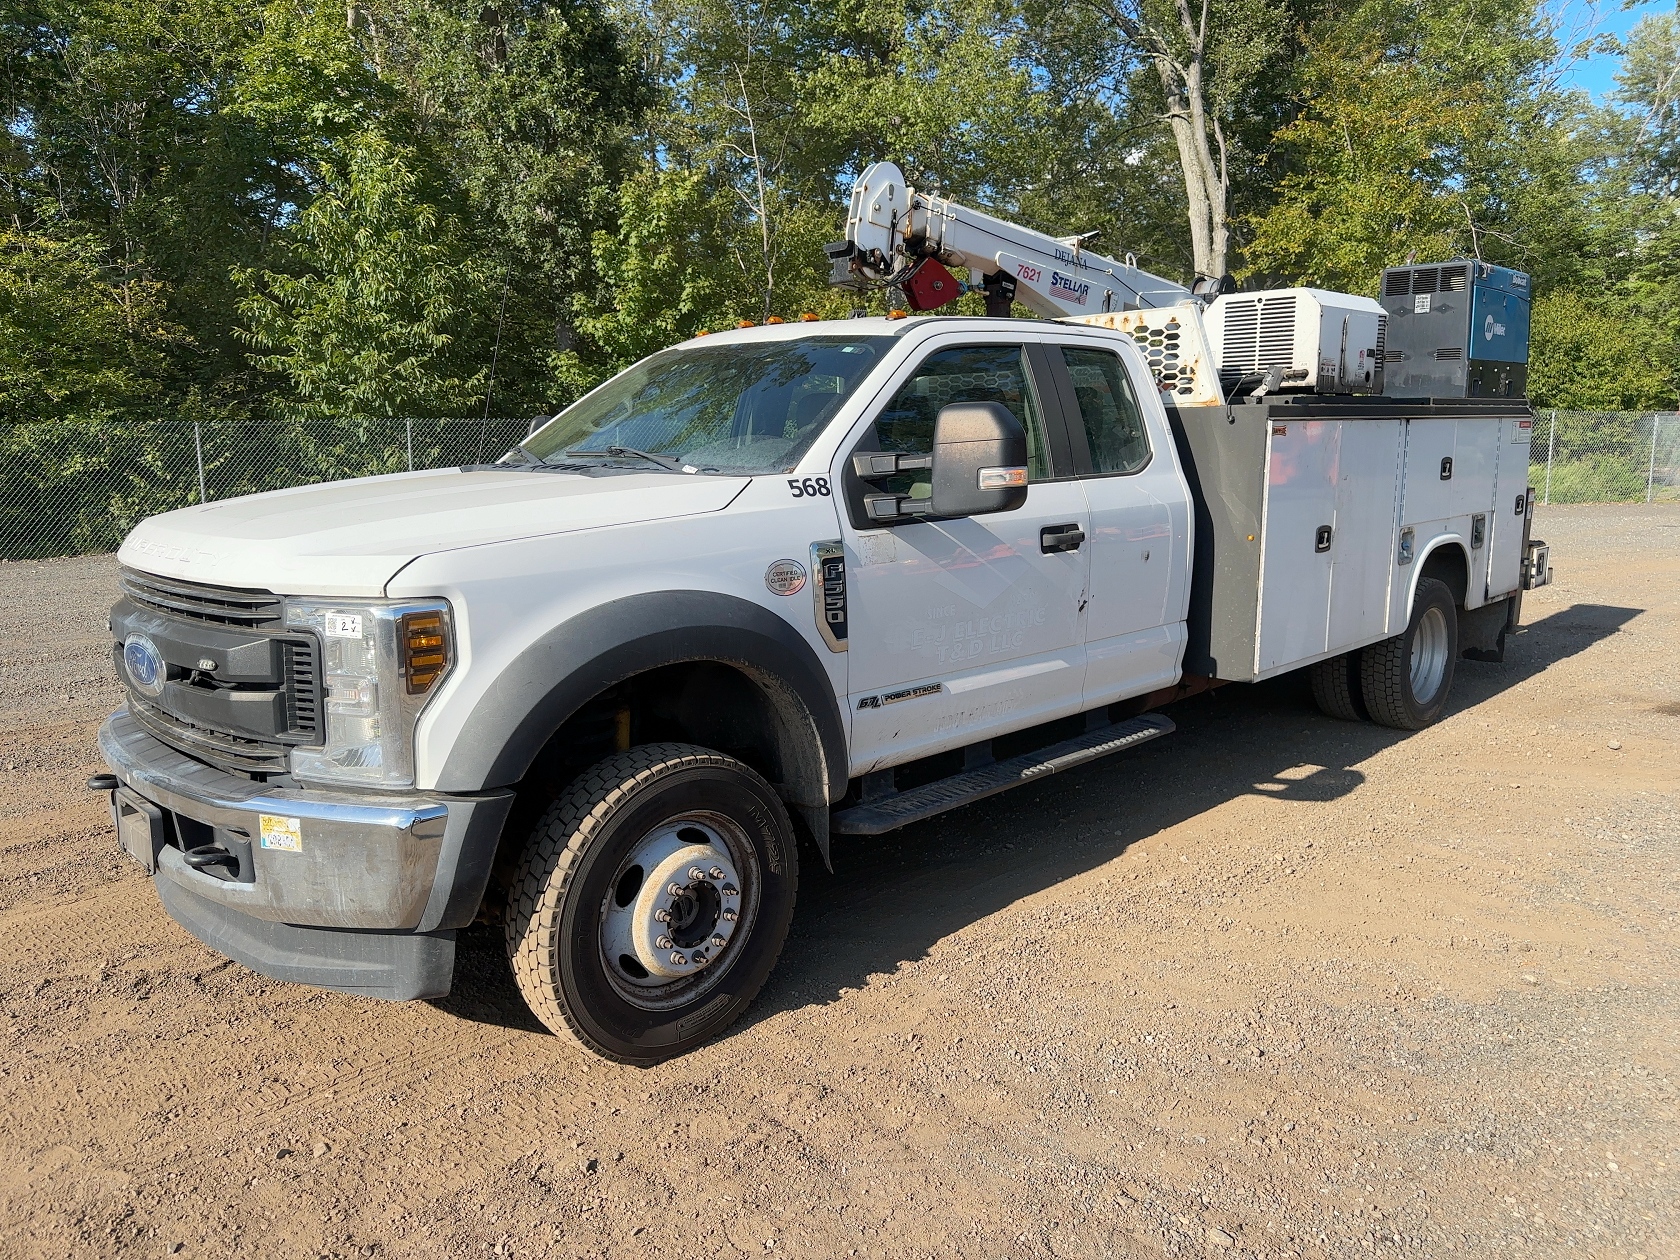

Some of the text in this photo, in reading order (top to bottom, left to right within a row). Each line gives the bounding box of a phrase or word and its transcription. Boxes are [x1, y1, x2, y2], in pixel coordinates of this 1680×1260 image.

[1054, 248, 1088, 271] DEJANA
[1016, 264, 1042, 283] 7621
[1050, 271, 1089, 296] STELLAR
[787, 477, 831, 498] 568
[772, 569, 798, 578] CERTIFIED
[952, 606, 1047, 643] ELECTRIC
[128, 648, 150, 680] Ford
[885, 690, 911, 702] POWER
[912, 683, 941, 696] STROKE
